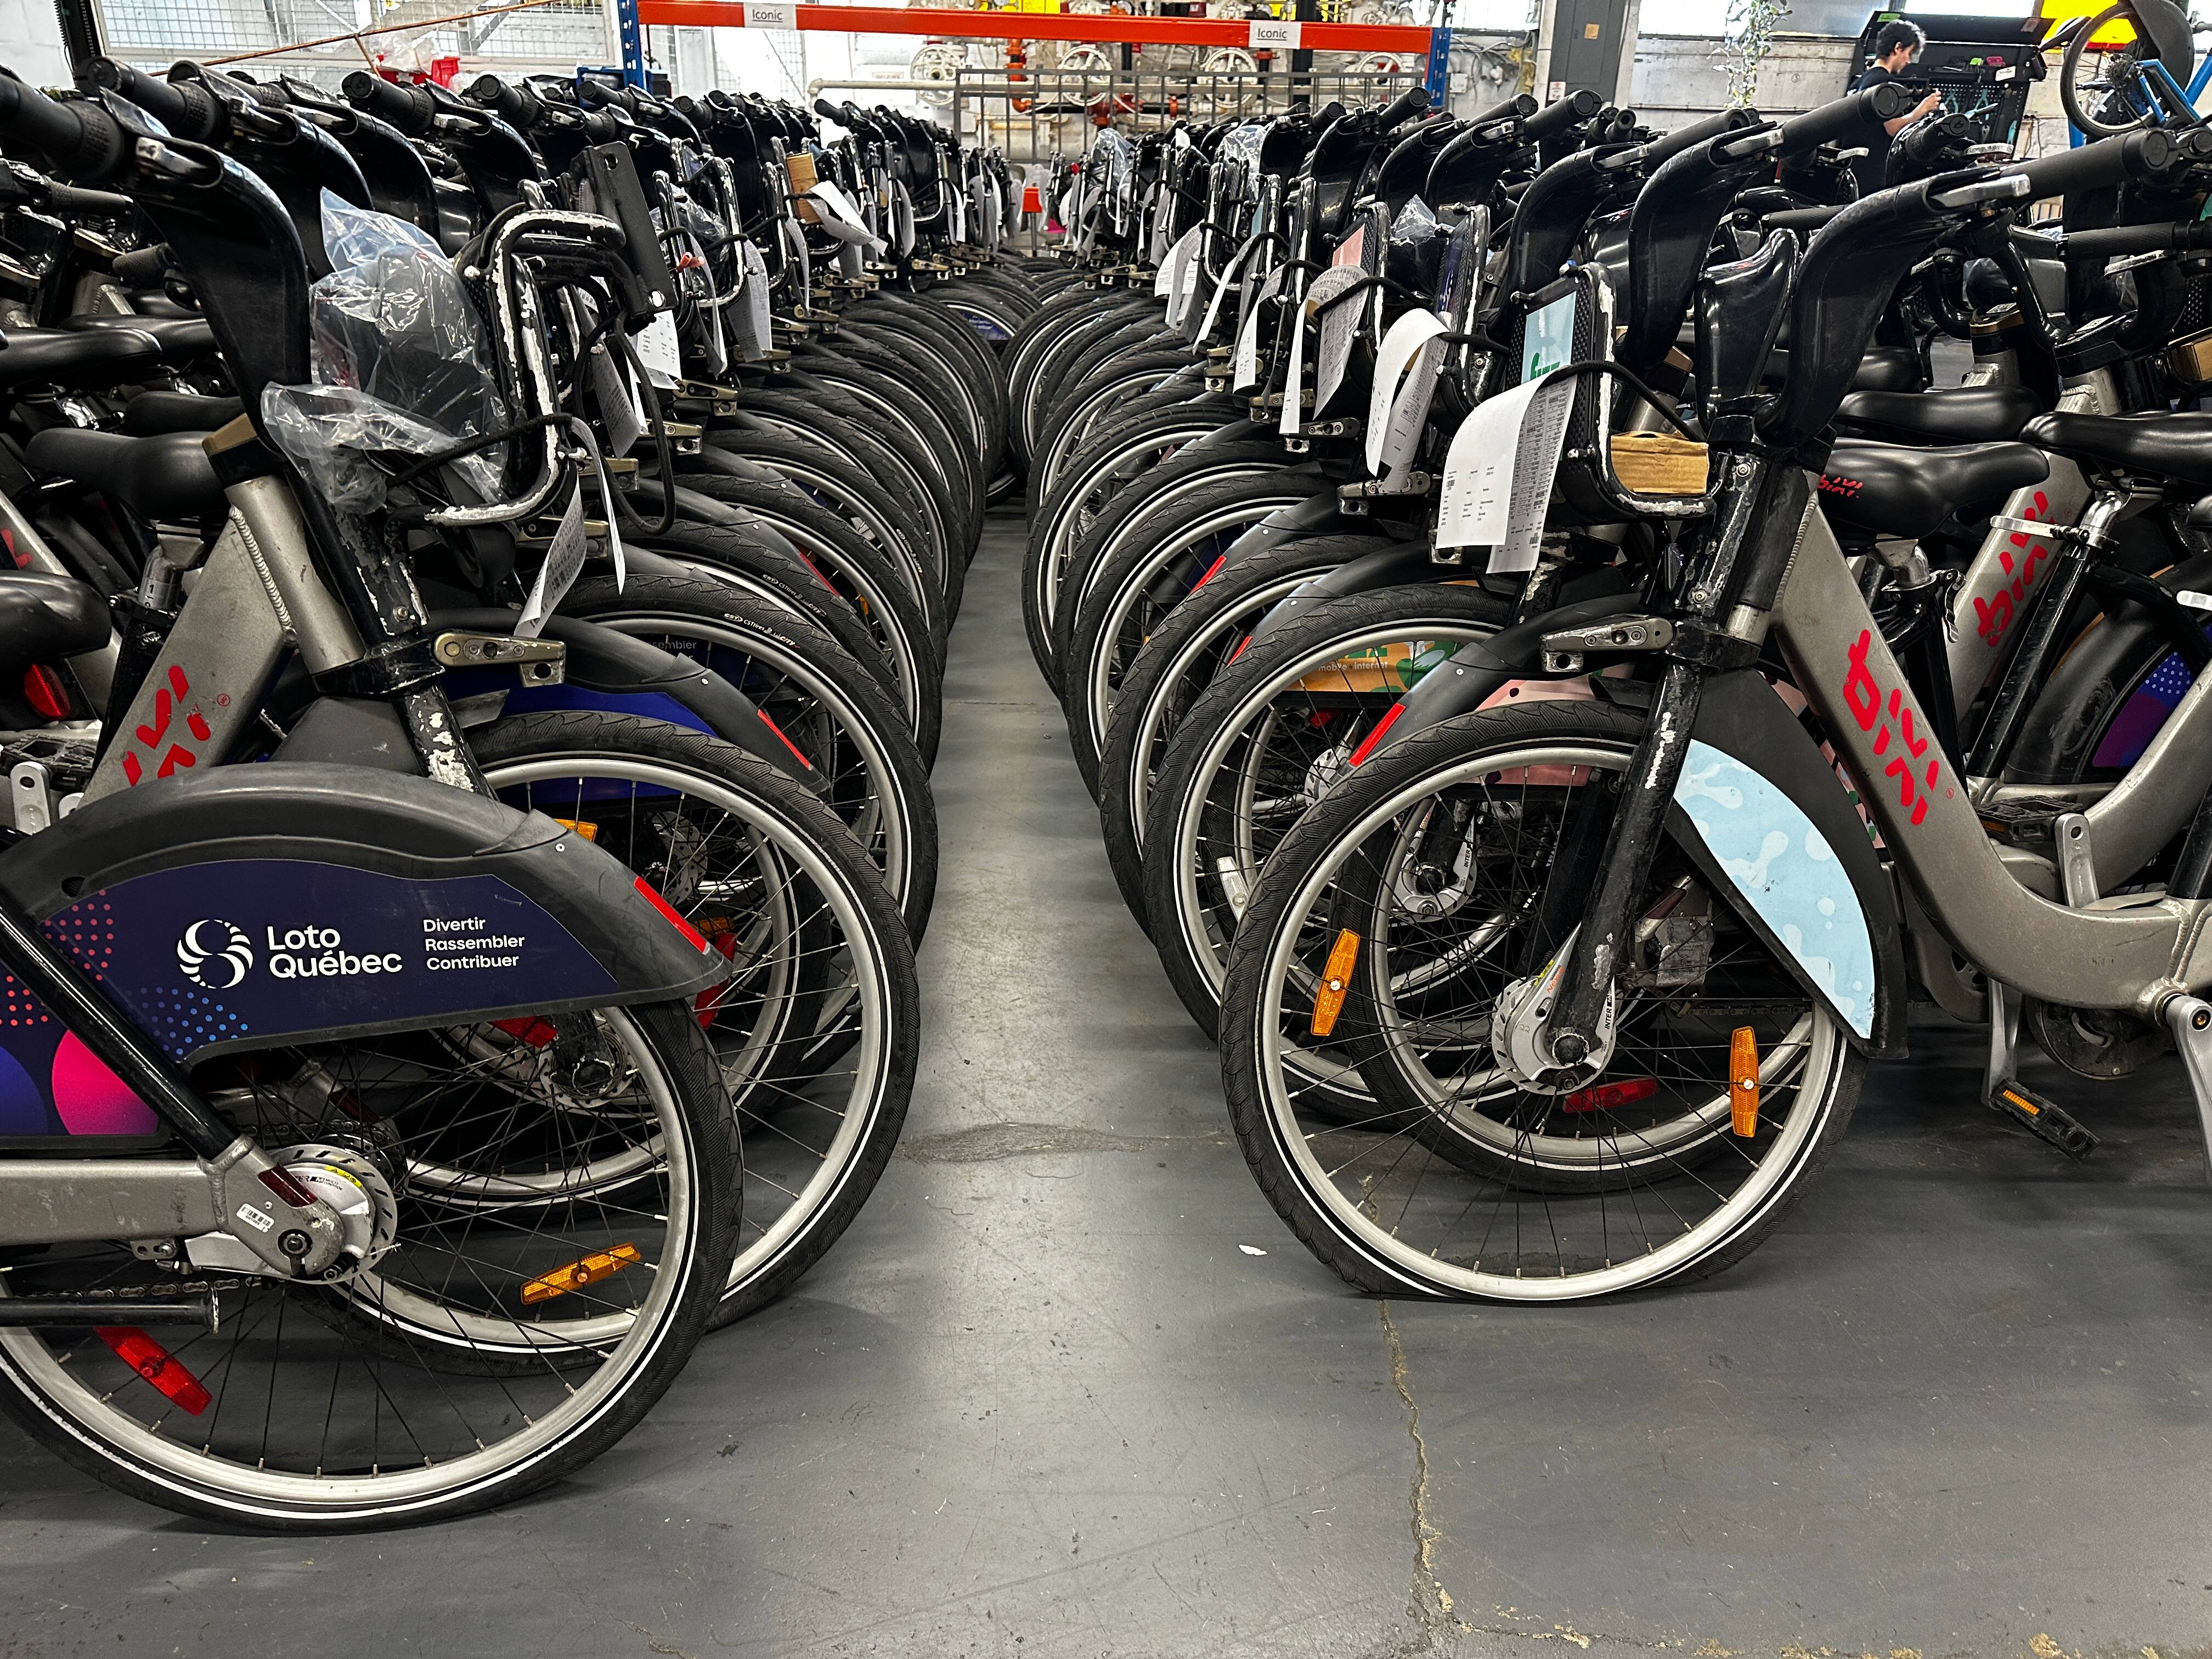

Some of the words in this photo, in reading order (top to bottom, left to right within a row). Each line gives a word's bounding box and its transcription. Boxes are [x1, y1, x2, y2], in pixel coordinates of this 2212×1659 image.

[752, 9, 783, 21] Iconic
[1257, 27, 1288, 39] Iconic
[648, 640, 697, 649] sembler
[1843, 629, 1939, 825] bixi
[423, 917, 486, 932] Divertir
[267, 925, 341, 951] Loto
[425, 935, 525, 951] Rassembler
[269, 949, 403, 979] Québec
[426, 955, 519, 970] Contribuer
